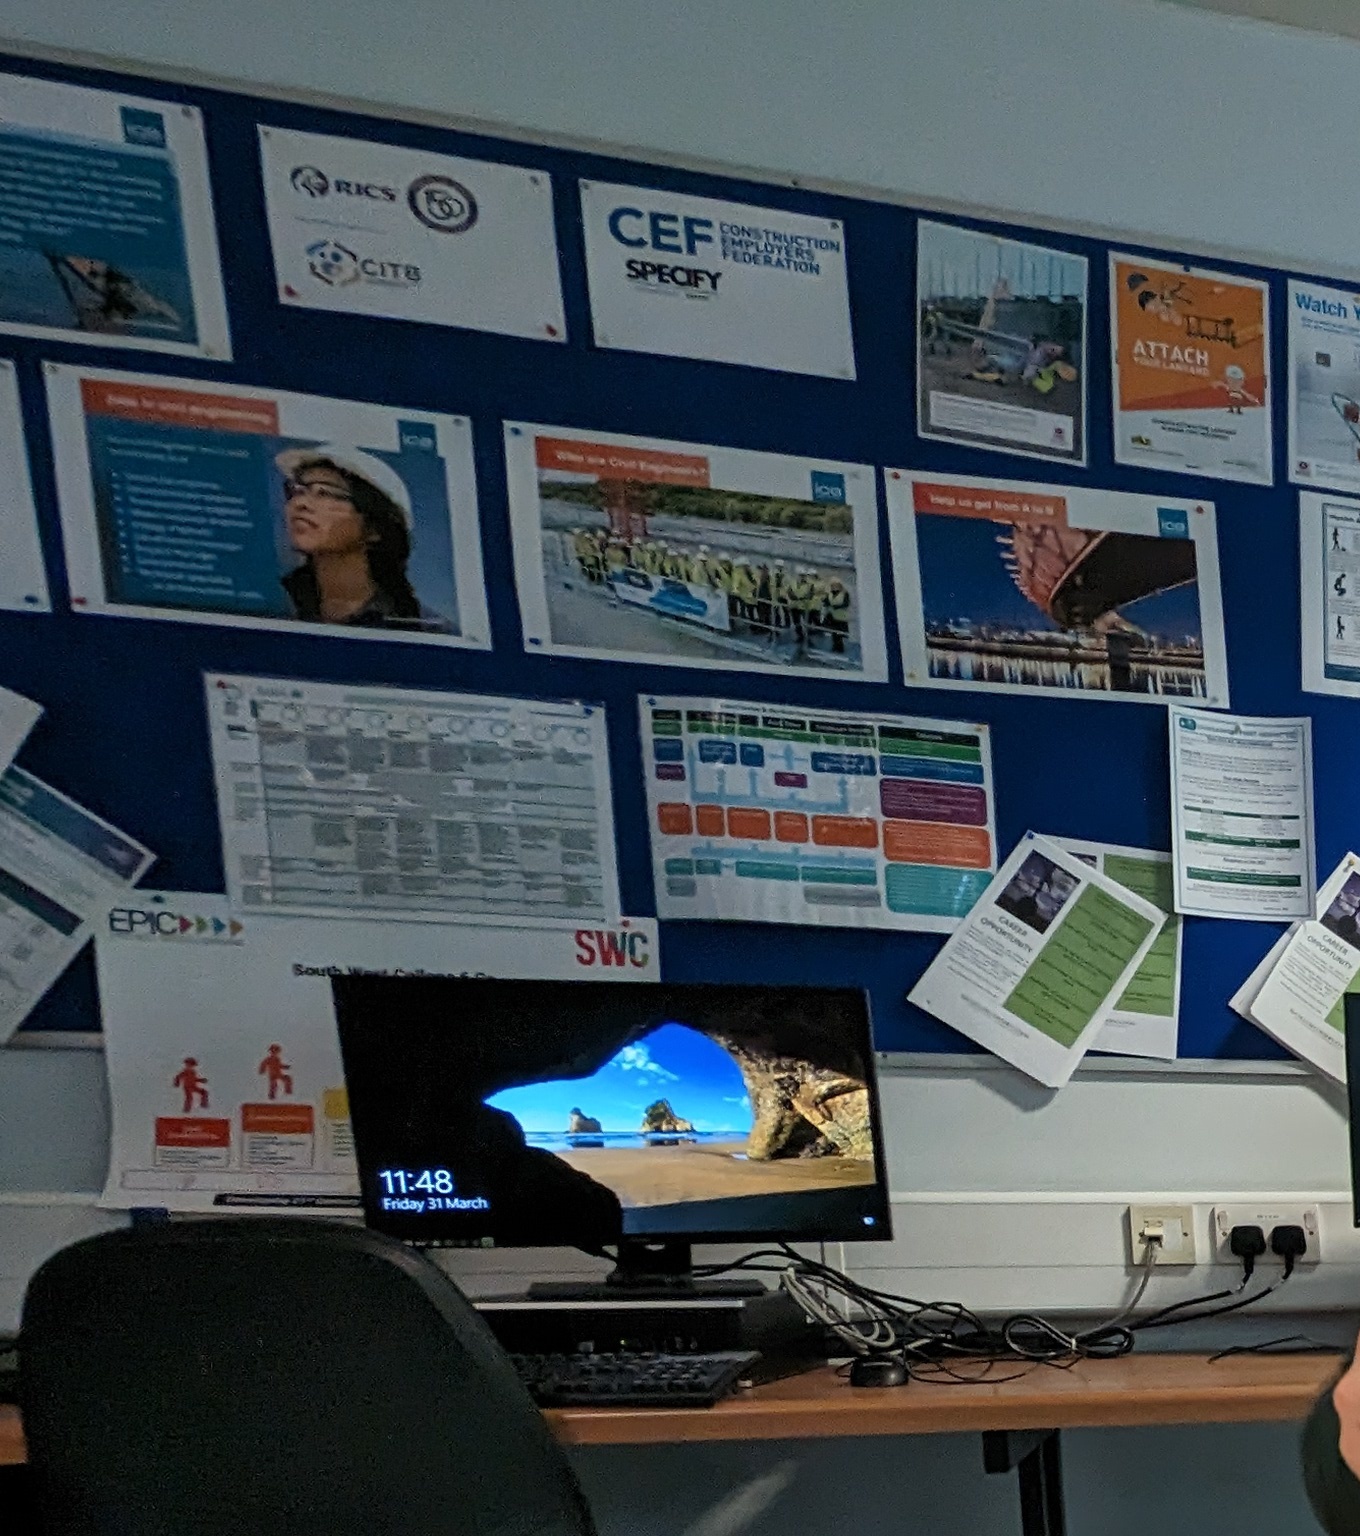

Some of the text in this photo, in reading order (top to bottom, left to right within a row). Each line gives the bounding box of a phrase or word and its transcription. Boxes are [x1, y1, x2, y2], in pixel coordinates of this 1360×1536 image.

[335, 180, 396, 203] RICS
[608, 206, 714, 256] CEF
[719, 221, 840, 254] CONSTRUCTION
[720, 237, 815, 262] EMPLOYERS
[721, 249, 821, 276] FEDERATION
[361, 258, 421, 283] CITB
[626, 259, 723, 292] SPECIFY
[1294, 291, 1348, 322] Watch
[1133, 338, 1209, 366] ATTACH
[109, 908, 179, 936] EPIC
[978, 916, 1034, 955] OPPORTUNITY
[997, 913, 1028, 939] CAREER
[575, 927, 650, 968] SWC
[1306, 933, 1354, 971] OPPORTUNITY
[1320, 933, 1349, 957] CAREER
[380, 1170, 453, 1194] 11:48
[383, 1197, 489, 1213] Friday 31 March
